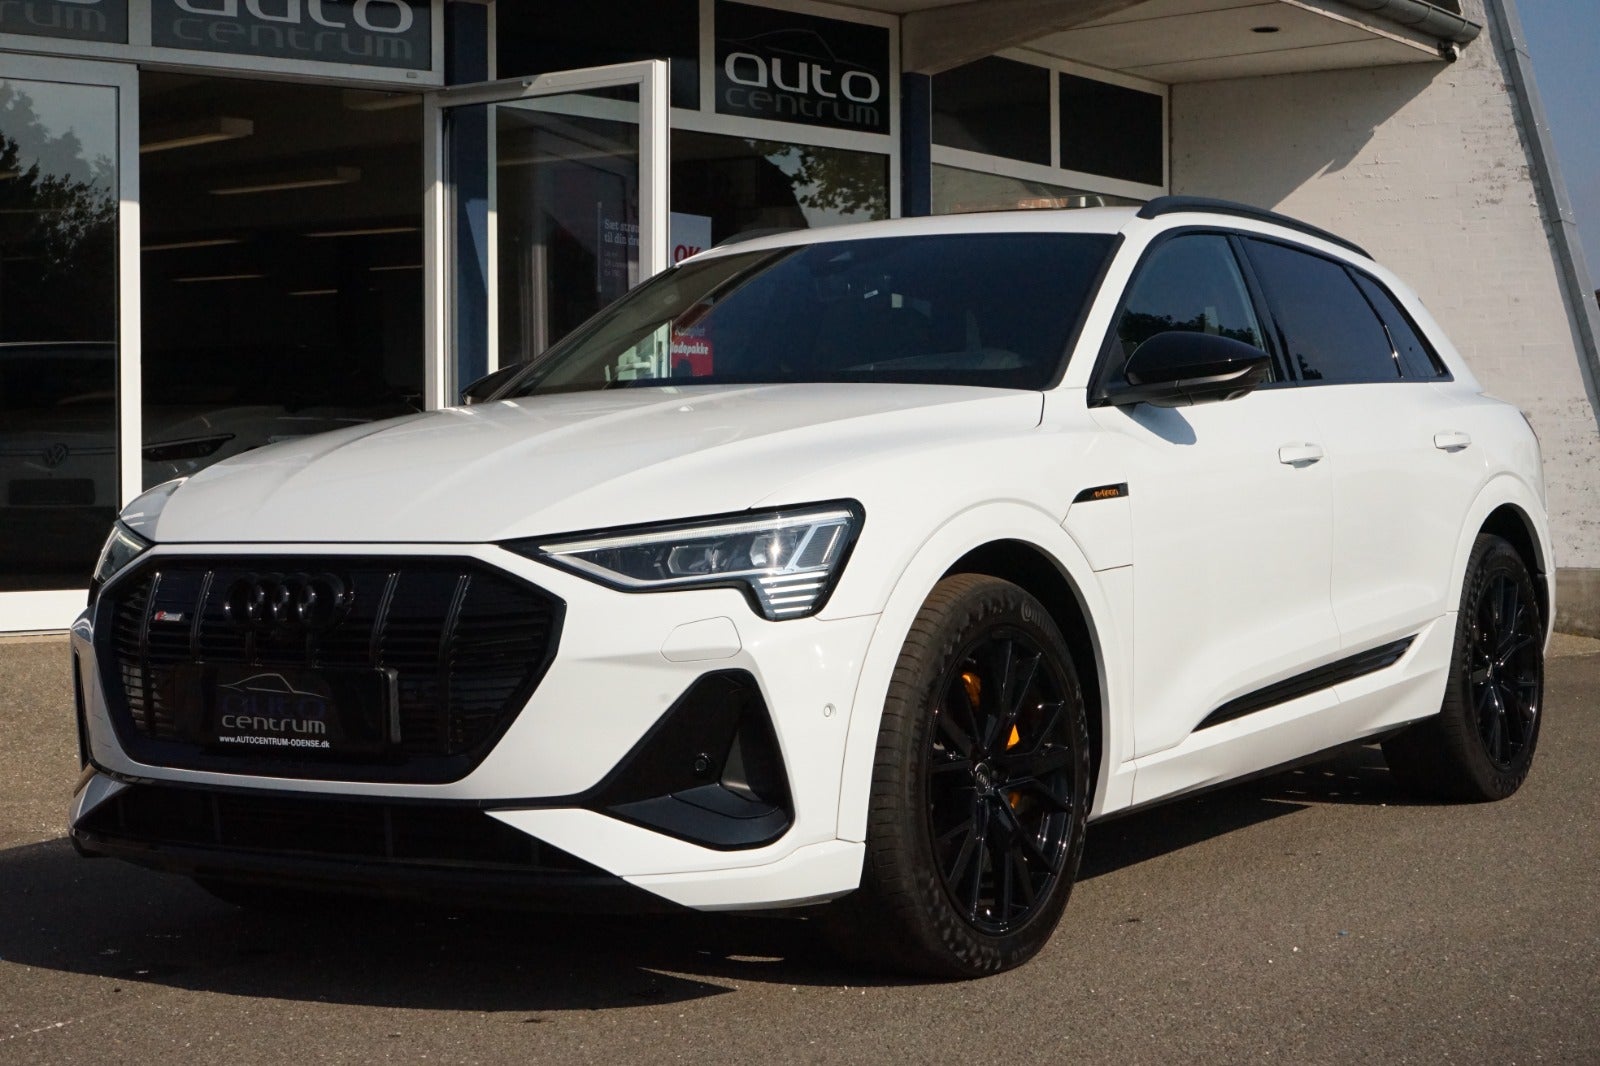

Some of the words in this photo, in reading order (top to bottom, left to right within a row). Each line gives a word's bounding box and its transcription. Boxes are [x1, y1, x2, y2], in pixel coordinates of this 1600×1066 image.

[172, 18, 414, 60] centrum
[724, 52, 880, 104] auto
[724, 88, 880, 127] centrum
[218, 735, 331, 749] www.AUTOCENTRUM-ODENSE.dk
[221, 714, 327, 734] centrum
